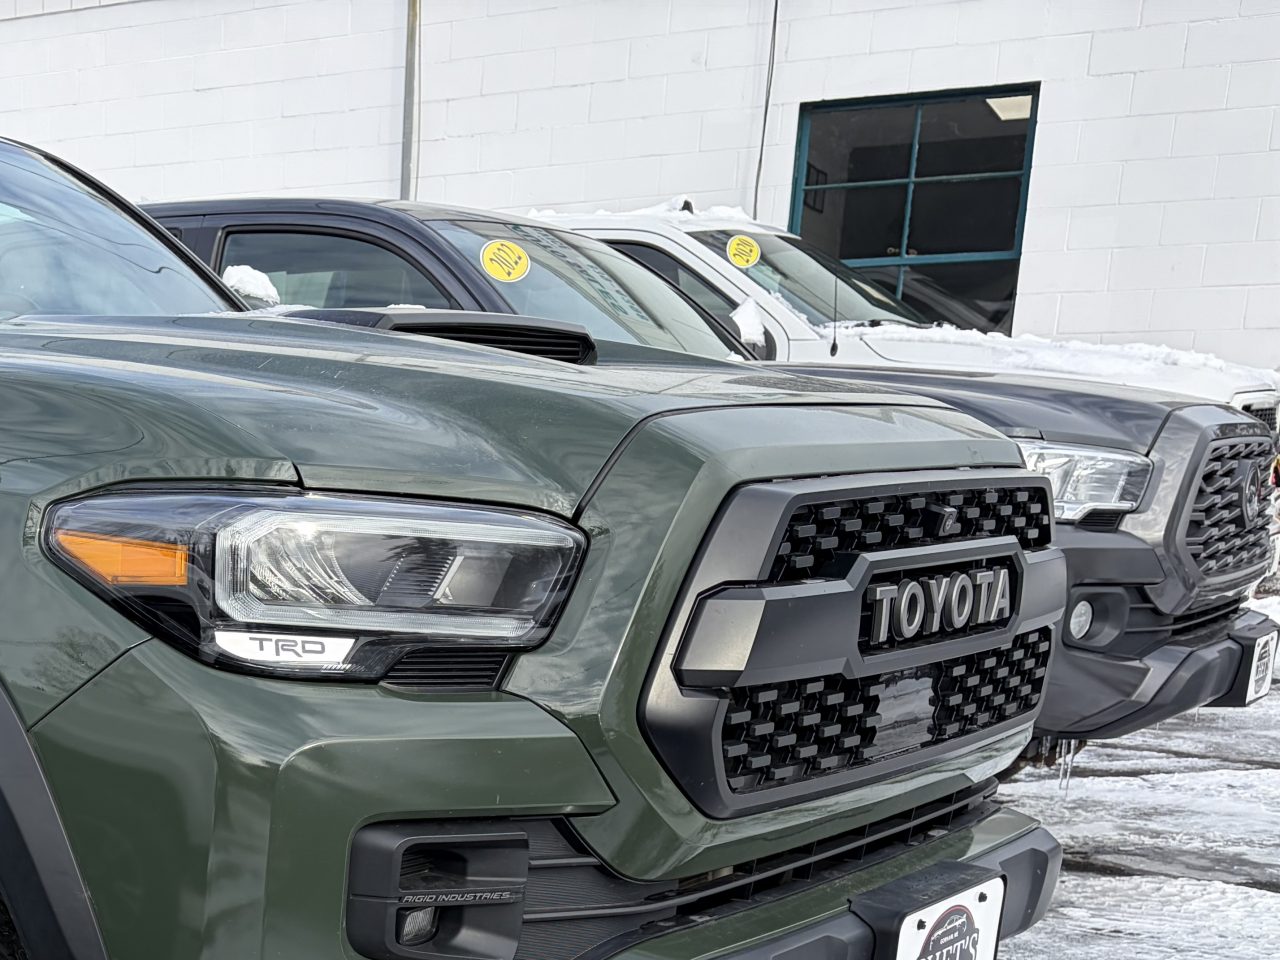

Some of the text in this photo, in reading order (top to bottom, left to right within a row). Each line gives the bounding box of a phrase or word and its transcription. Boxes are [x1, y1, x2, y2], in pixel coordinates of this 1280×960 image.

[489, 243, 522, 277] 2022
[733, 238, 755, 263] 2020
[867, 566, 1010, 645] TOYOTA
[249, 637, 326, 658] TRD
[403, 891, 511, 903] RIGID INDUSTRIES
